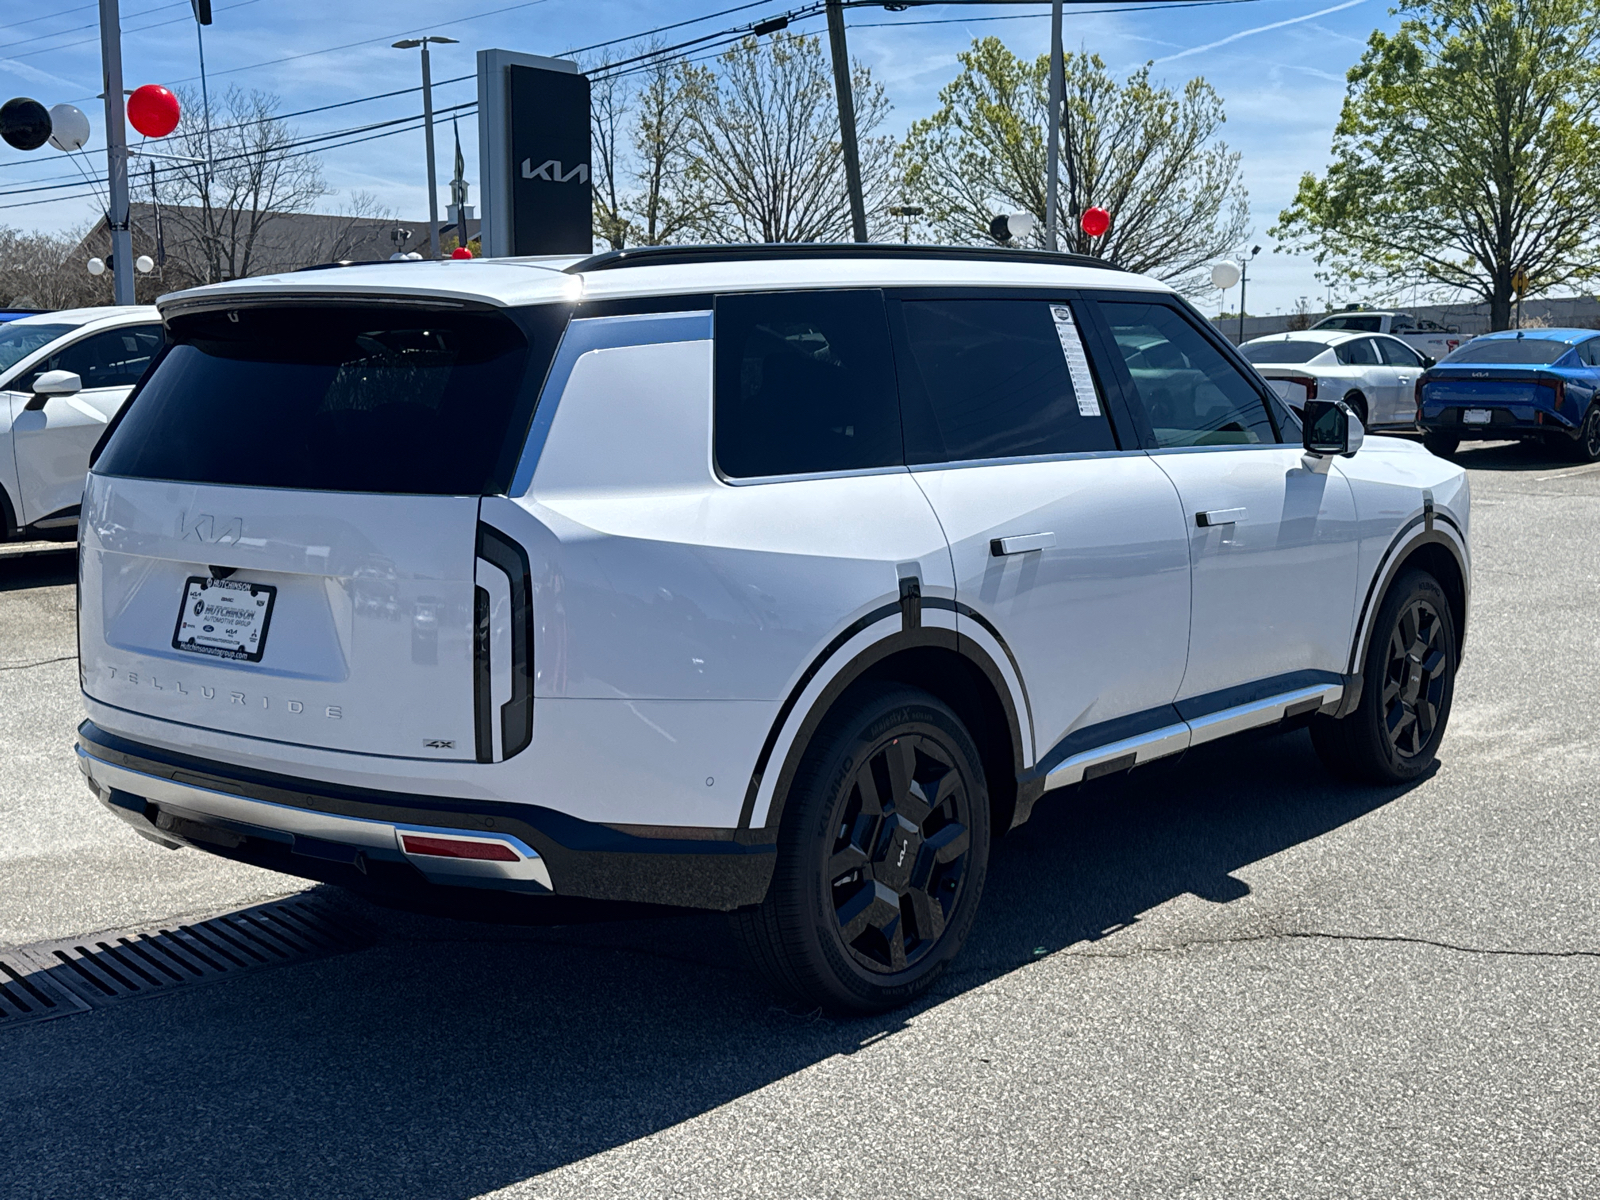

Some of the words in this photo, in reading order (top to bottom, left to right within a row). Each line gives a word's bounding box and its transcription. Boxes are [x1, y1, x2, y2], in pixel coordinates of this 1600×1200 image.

[521, 157, 589, 185] KIA
[213, 579, 251, 591] HUTCHINSON
[107, 665, 343, 719] TELLURIDE
